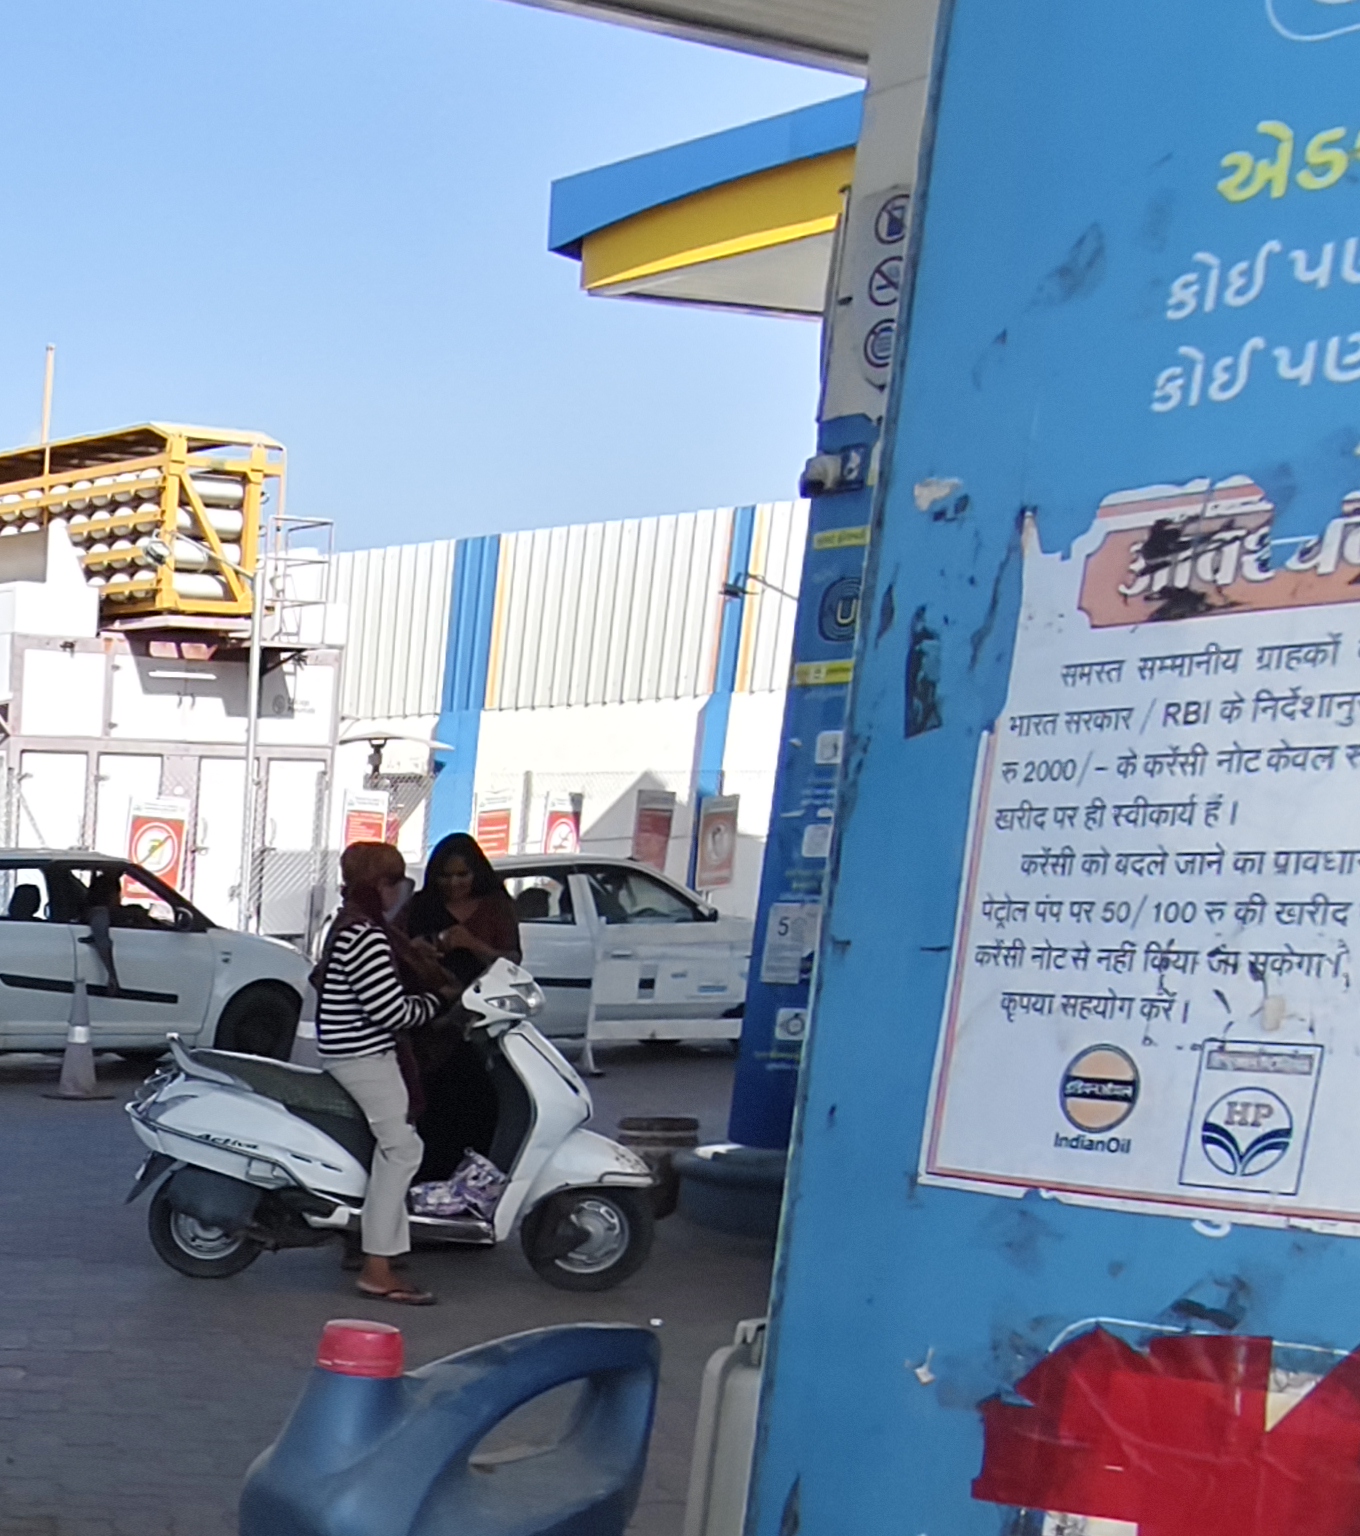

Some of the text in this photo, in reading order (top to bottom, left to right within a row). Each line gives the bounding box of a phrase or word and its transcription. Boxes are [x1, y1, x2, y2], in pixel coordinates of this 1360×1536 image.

[1217, 120, 1360, 202] એડ
[1061, 631, 1340, 688] समस्त सम्मानीय ग्राहकों
[1010, 712, 1056, 738] भारत
[1065, 706, 1133, 735] सरकार
[1163, 699, 1209, 727] RBI
[1219, 691, 1246, 724] के
[1252, 686, 1360, 728] निर्देशानु
[1117, 747, 1138, 780] के
[1143, 747, 1208, 778] करेंसी
[1218, 740, 1261, 777] नोट
[1266, 739, 1337, 772] केवल
[994, 800, 1046, 832] खरीद
[1054, 805, 1077, 832] पर
[1084, 797, 1105, 831] ही
[1112, 792, 1198, 830] स्वीकार्य
[1021, 843, 1360, 877] करेंसी को बदले जाने का प्रावधा
[982, 893, 1028, 929] पेट्रोल
[1034, 896, 1062, 922] पंप
[1070, 900, 1094, 925] पर
[1234, 894, 1268, 925] की
[1275, 893, 1351, 928] खरीद
[974, 938, 1024, 972] करेंसी
[1031, 940, 1066, 972] नोट
[1070, 941, 1090, 972] से
[1097, 941, 1137, 974] नहीं
[1145, 941, 1199, 974] किया
[1000, 990, 1055, 1022] कृपया
[1061, 988, 1133, 1019] सहयोग
[1224, 1100, 1274, 1128] HP
[196, 1133, 259, 1150] Activa
[1054, 1132, 1132, 1154] IndianOil
